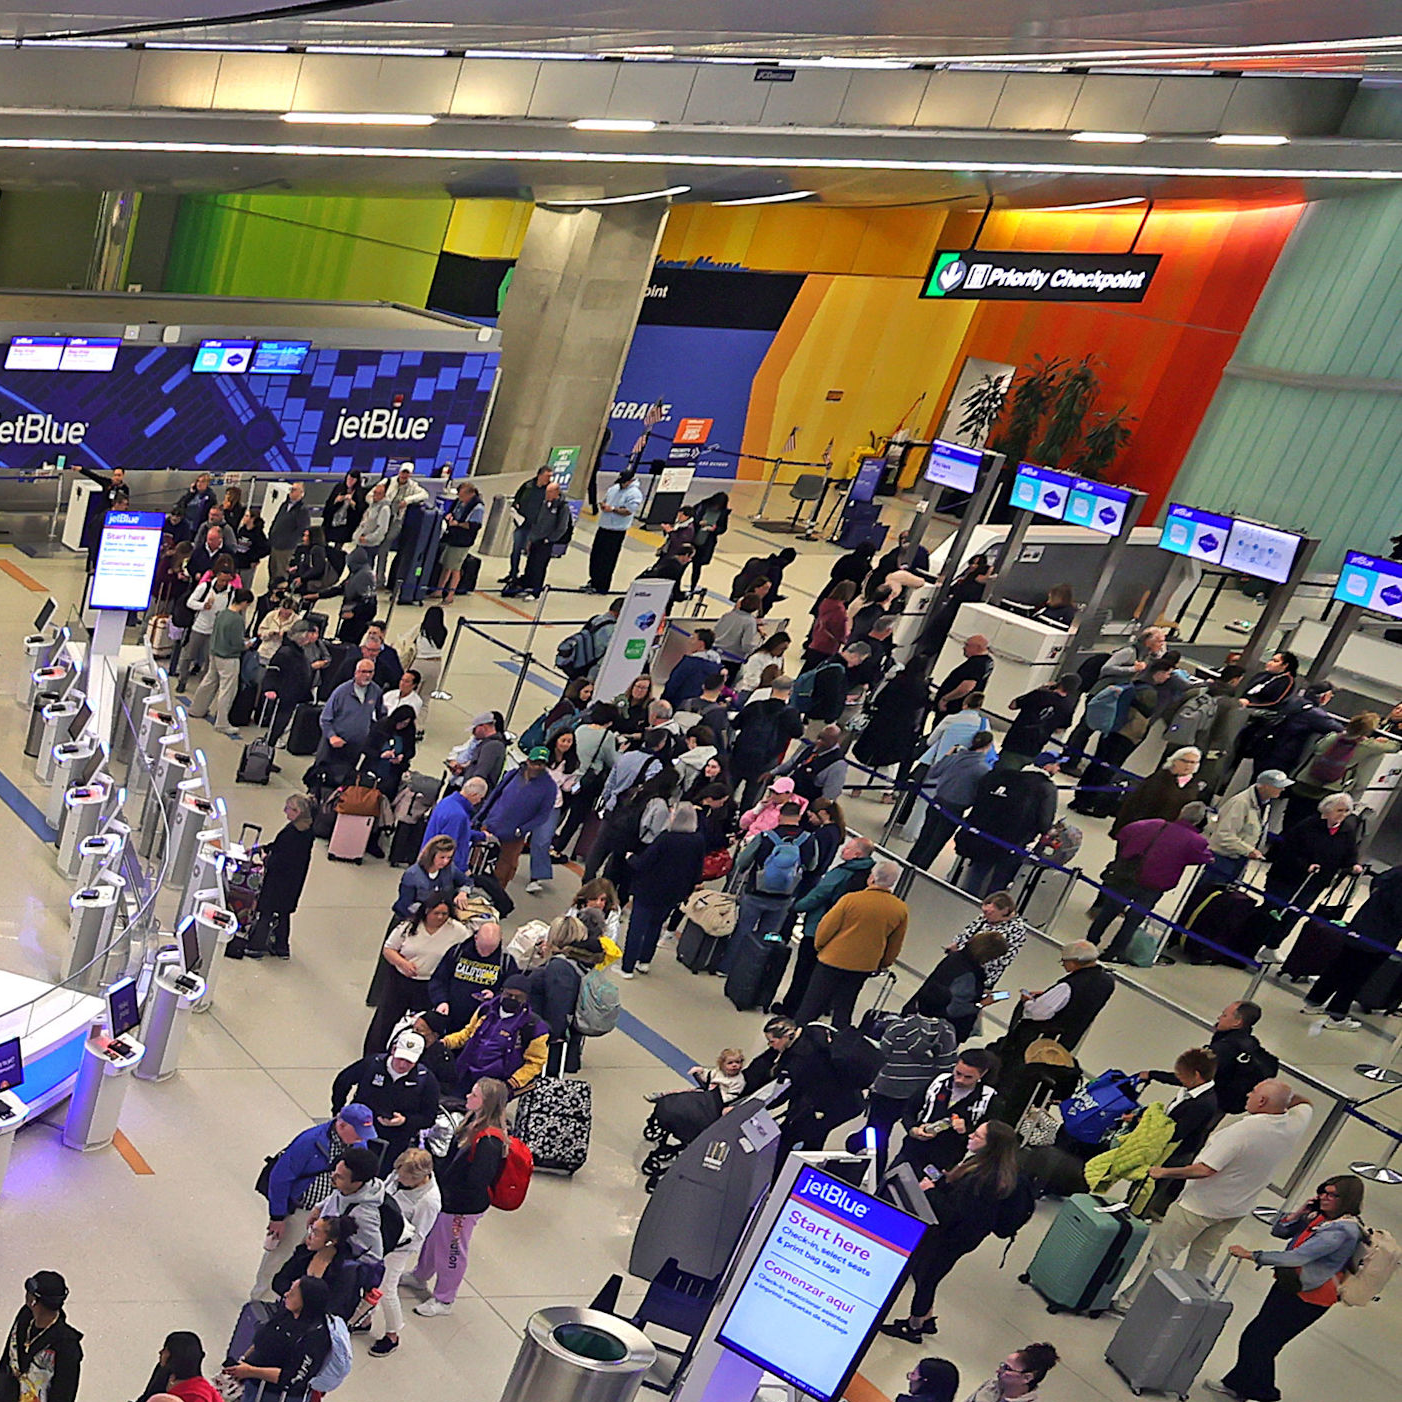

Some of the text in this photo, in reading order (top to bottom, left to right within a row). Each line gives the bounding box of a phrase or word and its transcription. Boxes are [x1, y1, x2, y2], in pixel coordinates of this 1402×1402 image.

[987, 268, 1146, 293] Priority Checkpoint
[330, 408, 433, 447] jetBlue
[800, 1174, 871, 1219] jetBlue
[787, 1209, 871, 1261] Start here
[782, 1240, 804, 1255] print
[804, 1250, 821, 1265] bag
[821, 1260, 840, 1276] tags
[820, 1246, 847, 1264] select
[846, 1259, 871, 1277] seats
[762, 1258, 856, 1315] Comenzar aquí
